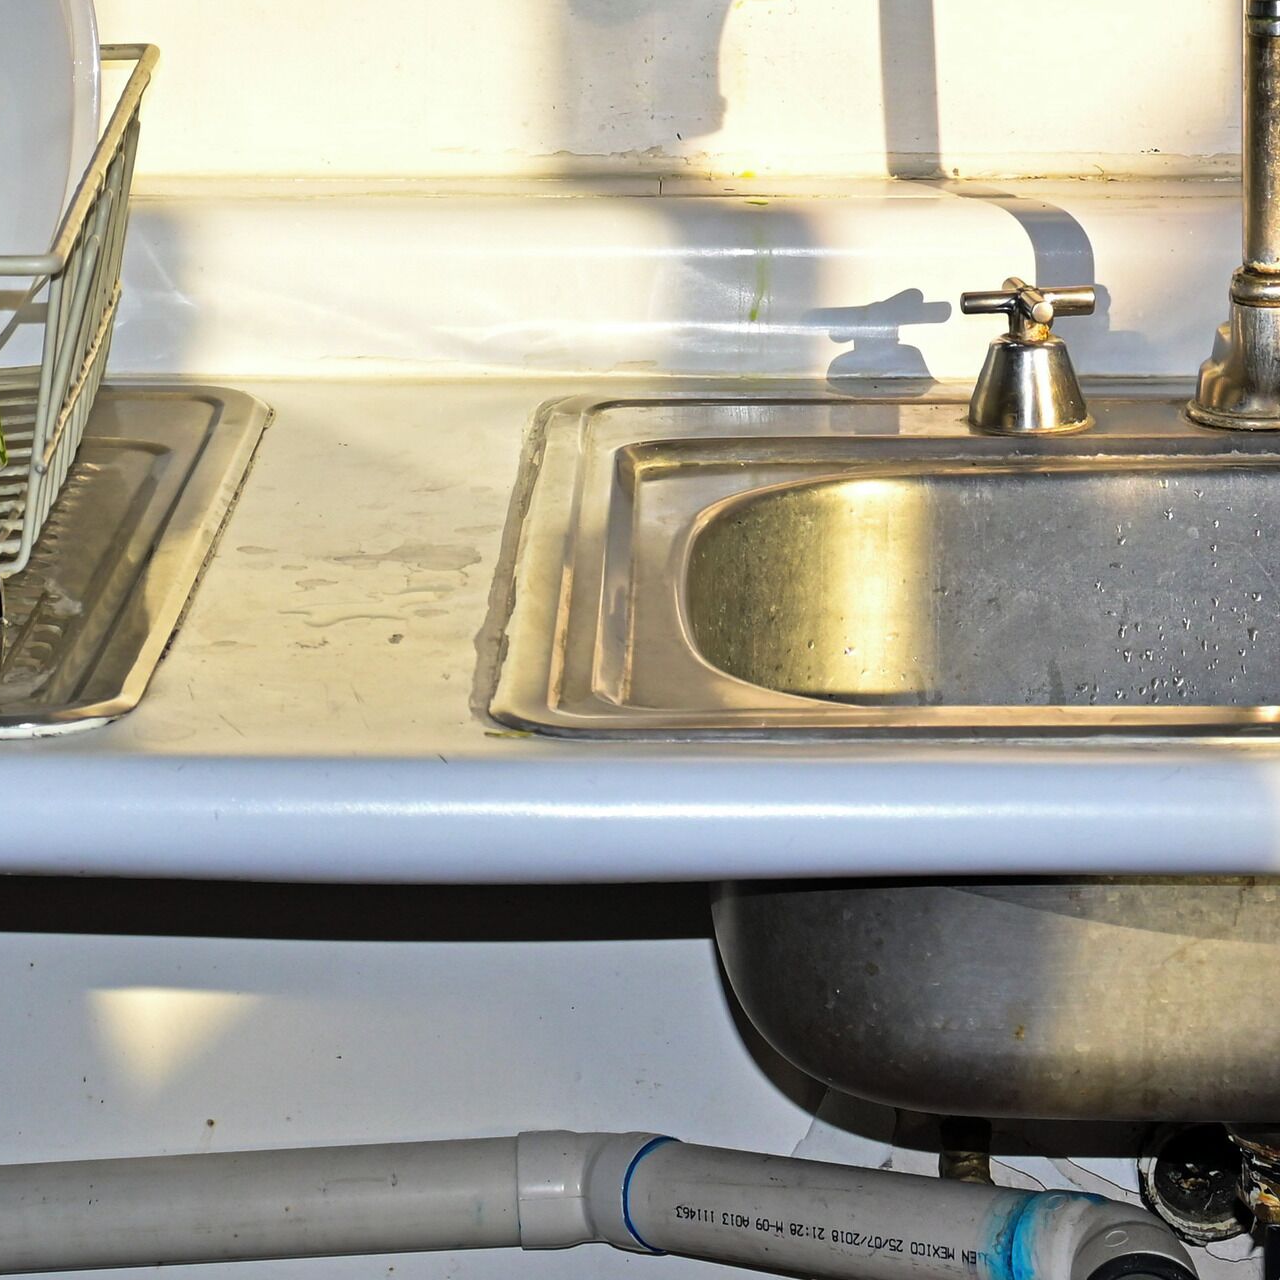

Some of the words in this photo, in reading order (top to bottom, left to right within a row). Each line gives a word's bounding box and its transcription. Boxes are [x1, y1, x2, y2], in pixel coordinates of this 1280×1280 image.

[676, 1206, 714, 1223] 111463
[722, 1212, 750, 1227] A013
[755, 1217, 783, 1233] M-09
[789, 1223, 824, 1240] 21:28
[831, 1229, 903, 1253] 25/07/2018
[910, 1241, 955, 1261] MEXICO
